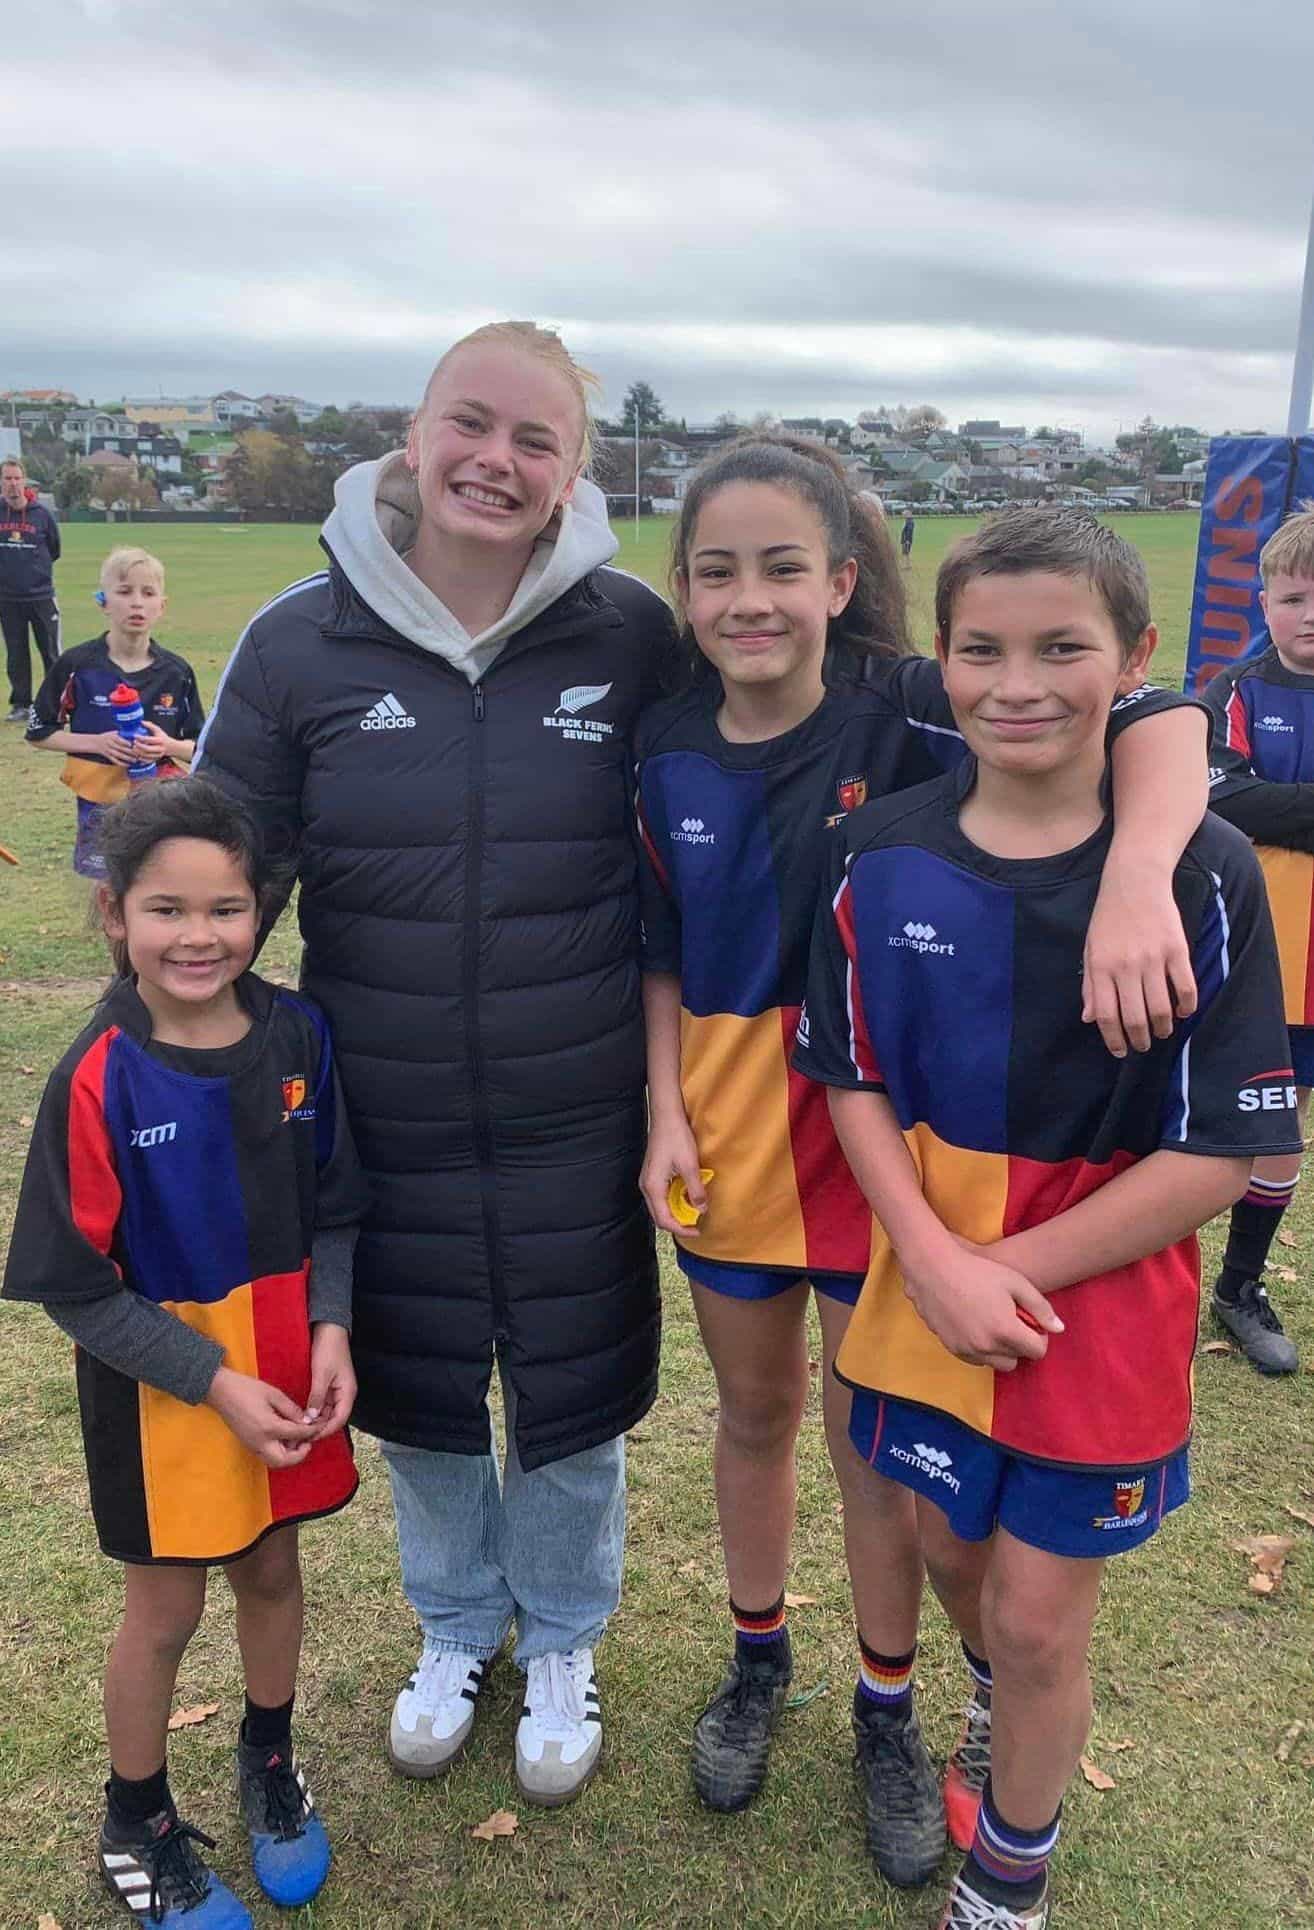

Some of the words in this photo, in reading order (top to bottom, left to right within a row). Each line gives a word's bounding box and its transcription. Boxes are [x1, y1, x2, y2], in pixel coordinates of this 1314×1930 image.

[360, 714, 416, 731] adidas
[543, 716, 582, 730] BLACK
[584, 719, 614, 734] FERNS
[562, 728, 603, 743] SEVENS
[888, 936, 954, 956] xcmsport
[130, 1122, 176, 1147] xcm
